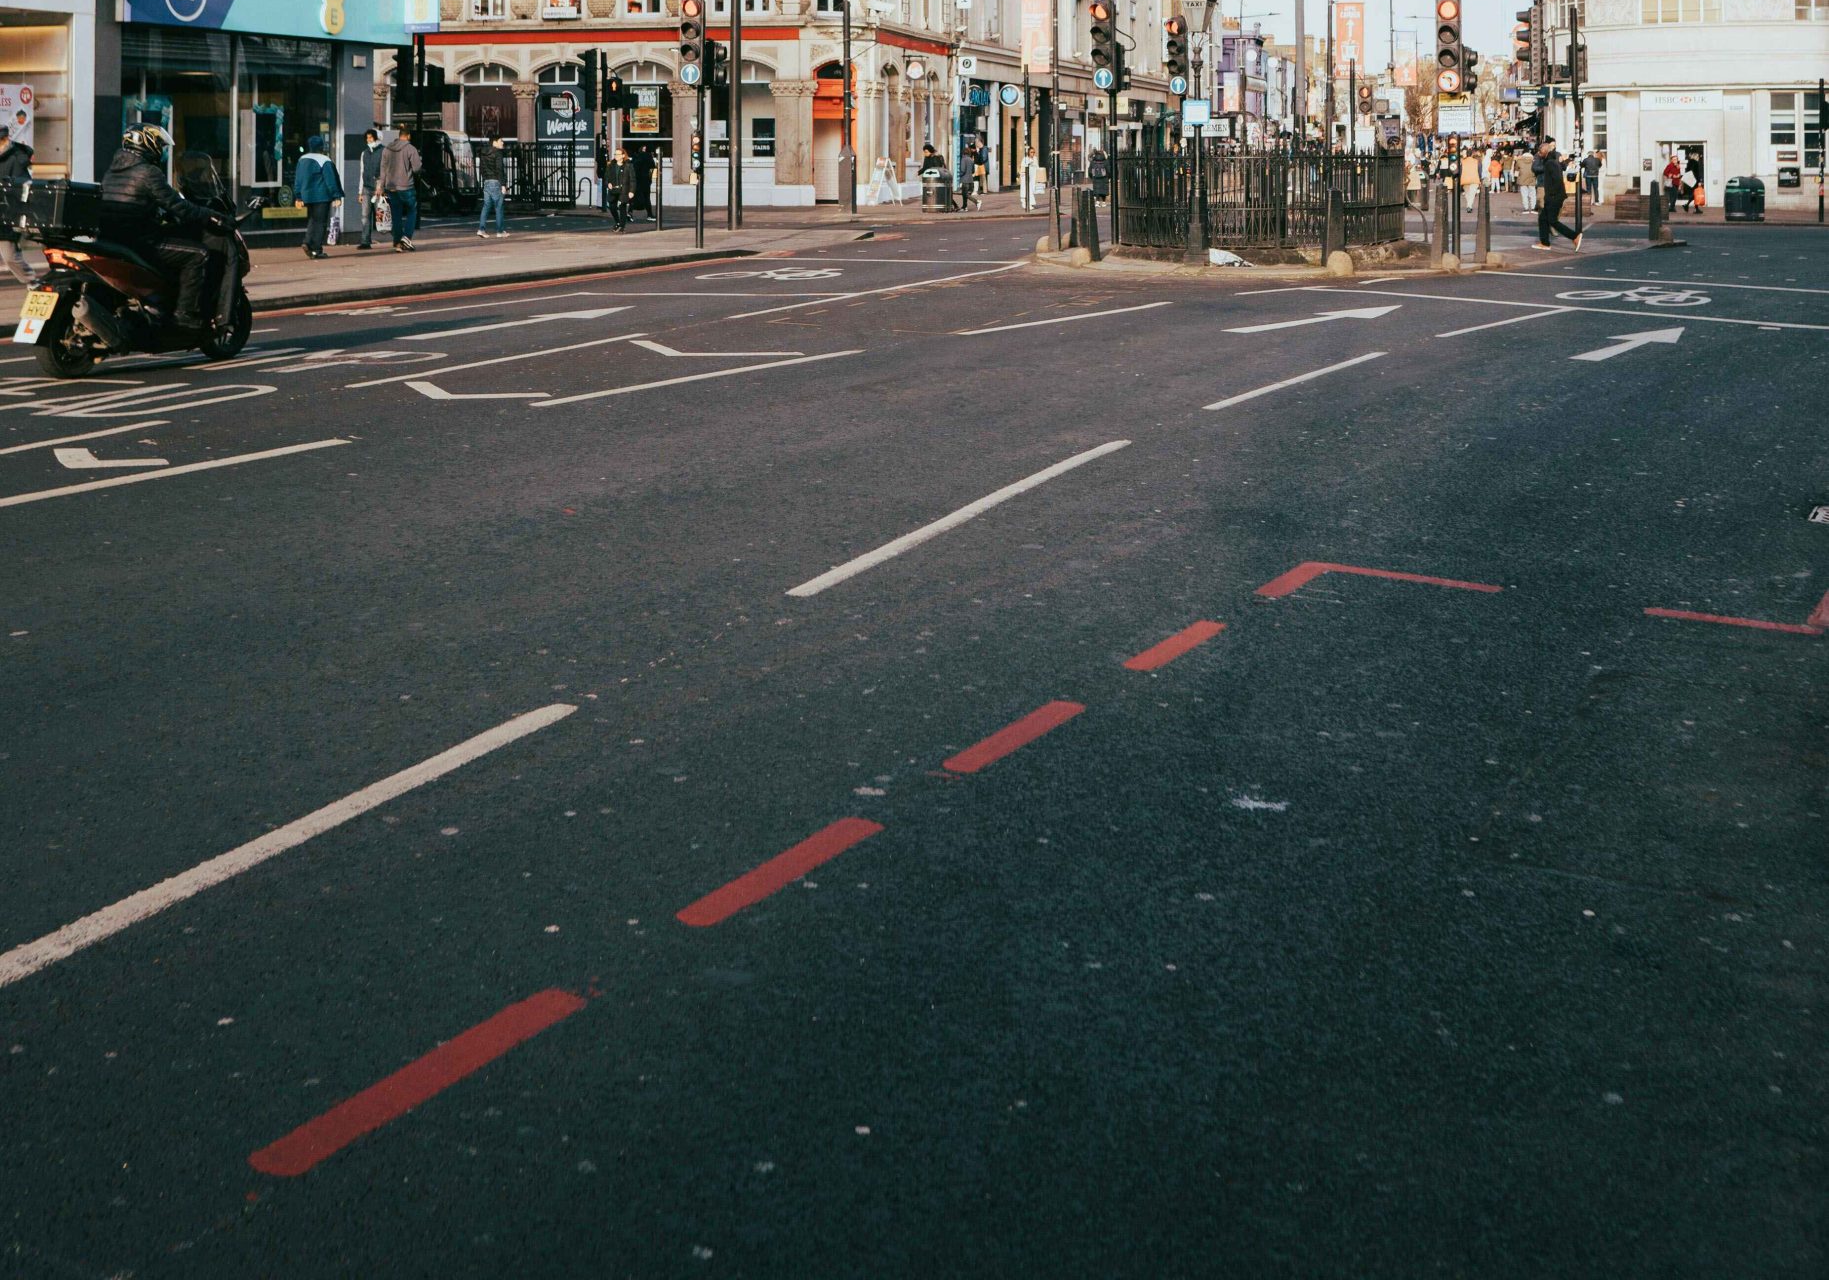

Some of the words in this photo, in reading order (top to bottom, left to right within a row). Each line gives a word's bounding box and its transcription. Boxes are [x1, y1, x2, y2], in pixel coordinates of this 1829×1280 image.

[1655, 95, 1680, 105] HSBC
[1693, 95, 1708, 105] UK
[546, 118, 588, 136] Wendy's
[1184, 124, 1228, 132] GELEMEN
